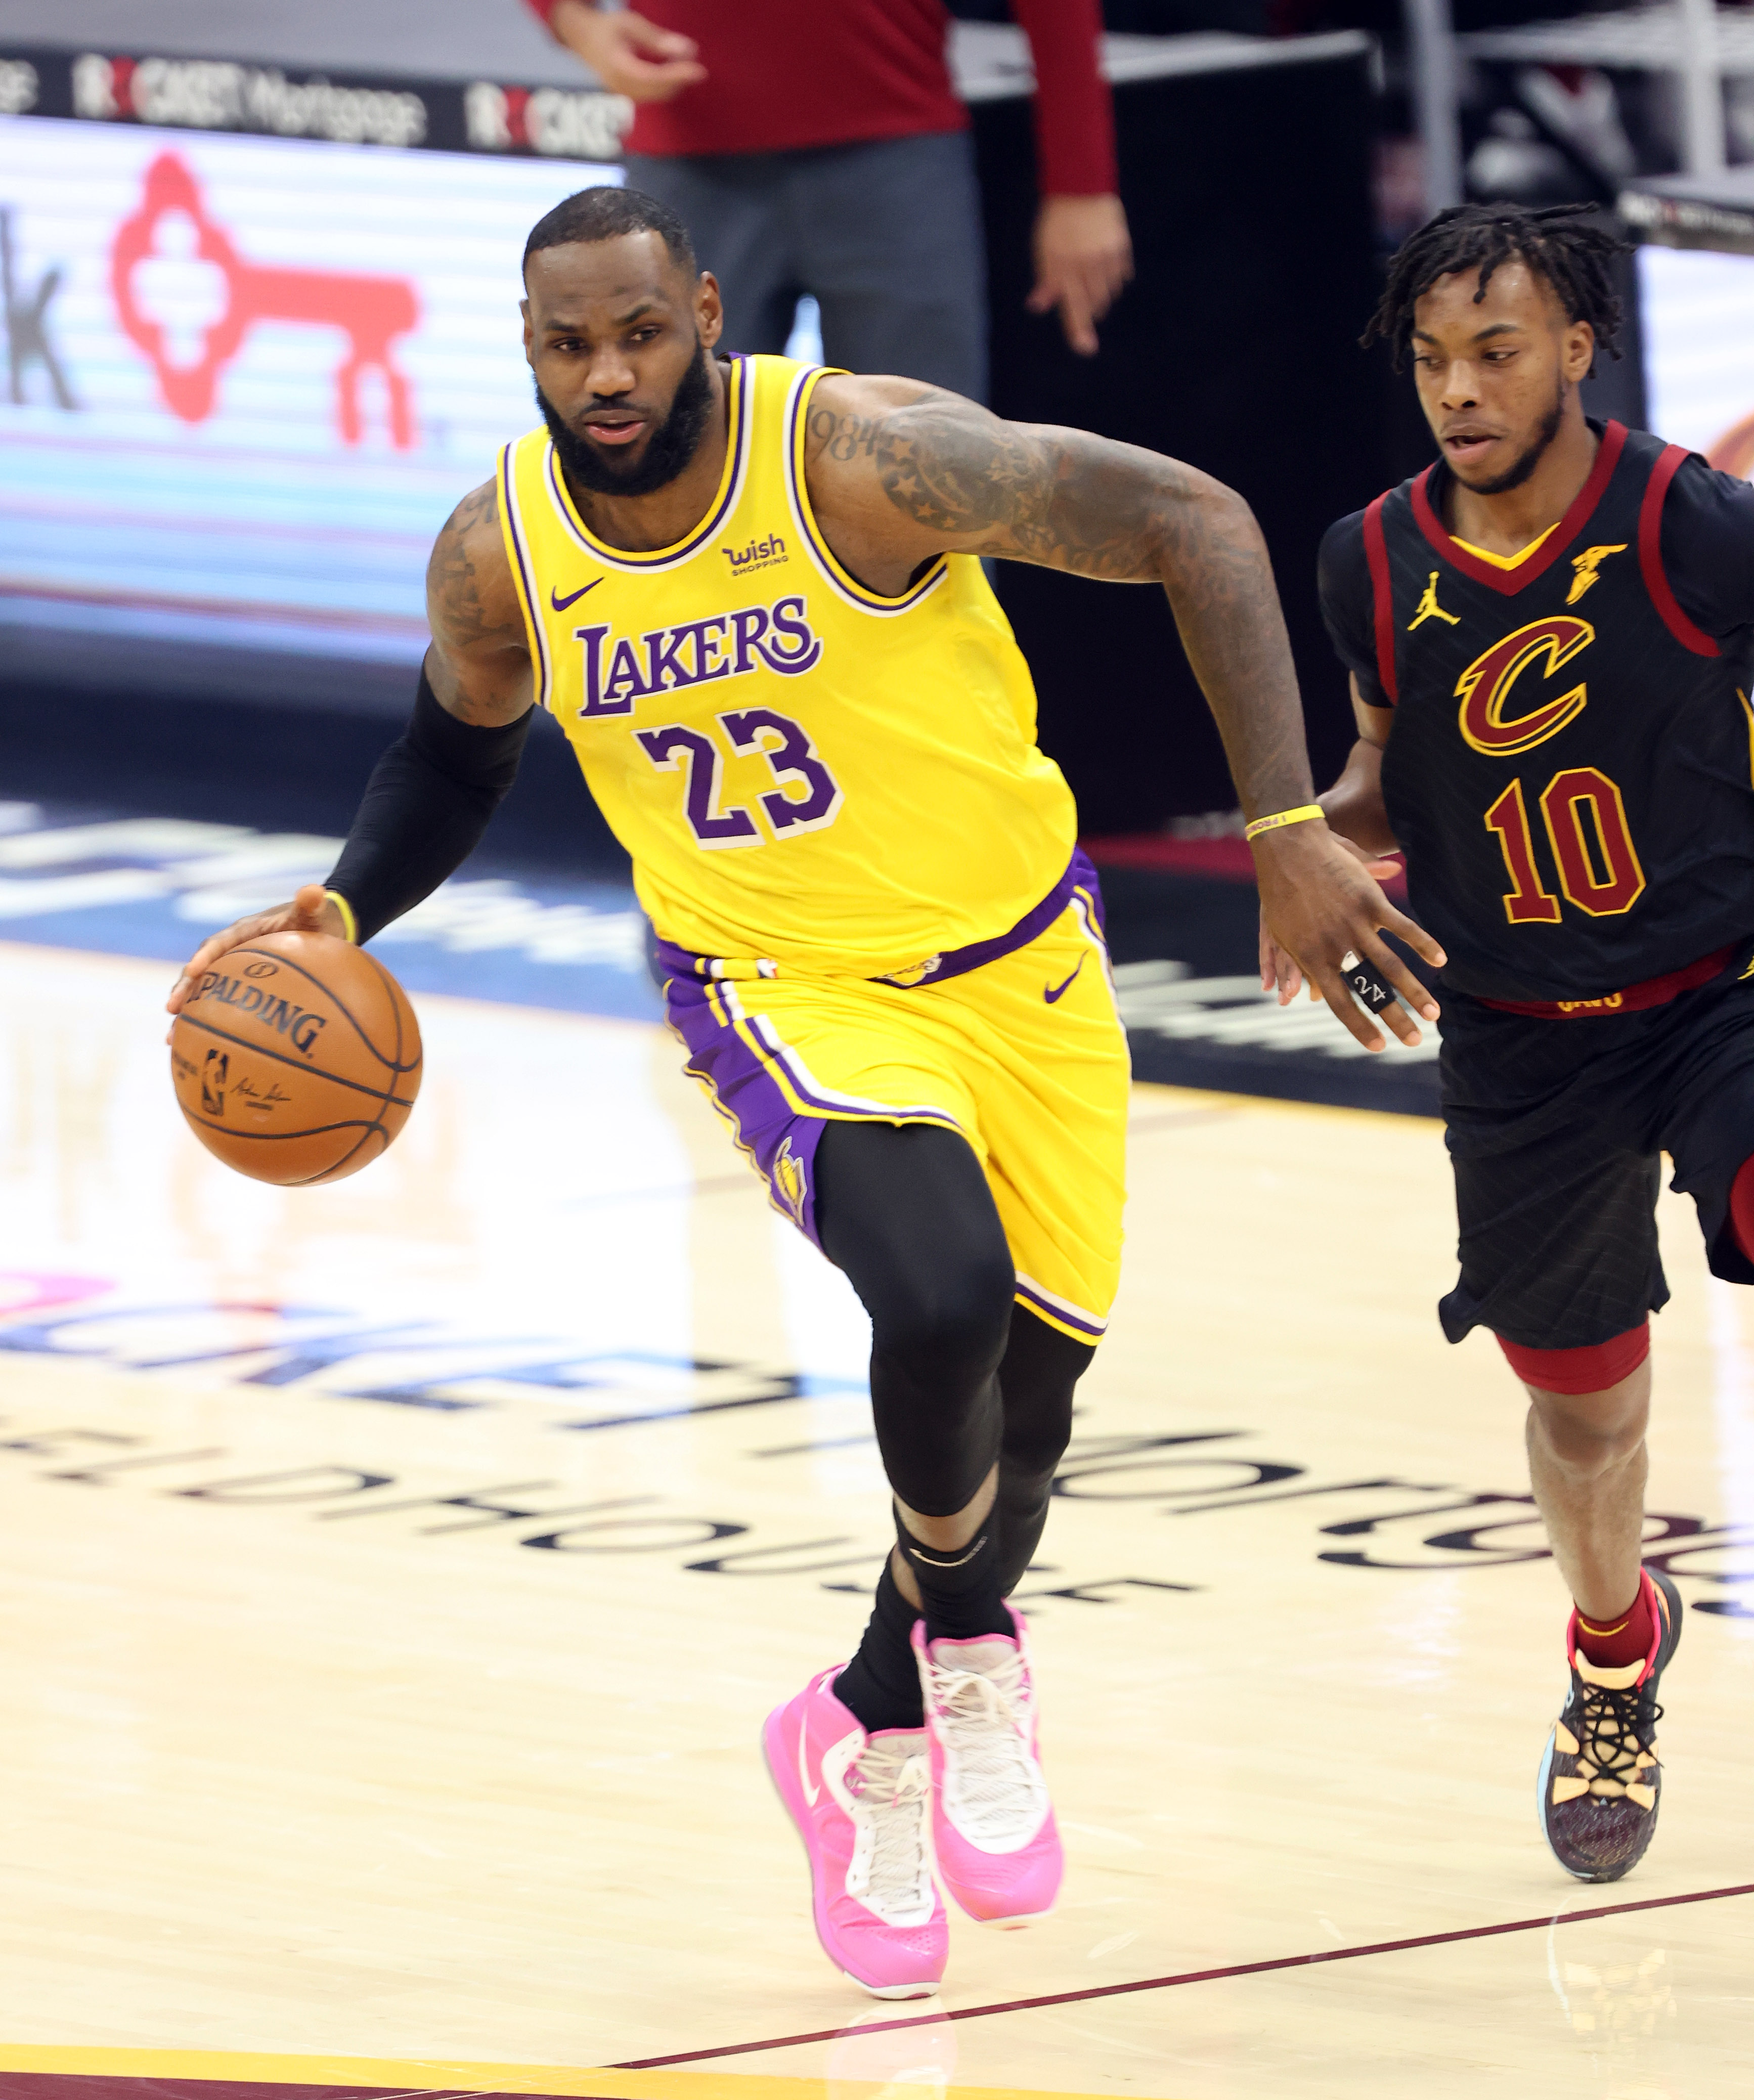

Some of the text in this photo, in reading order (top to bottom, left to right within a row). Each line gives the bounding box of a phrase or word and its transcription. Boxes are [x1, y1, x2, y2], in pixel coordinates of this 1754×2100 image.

[722, 533, 785, 565] wish
[732, 555, 788, 576] SHOPPING
[573, 594, 823, 719] LAKERS
[631, 706, 845, 850] 23
[1484, 766, 1646, 924] 10
[186, 971, 326, 1054] PALDING
[1354, 976, 1386, 1002] 24
